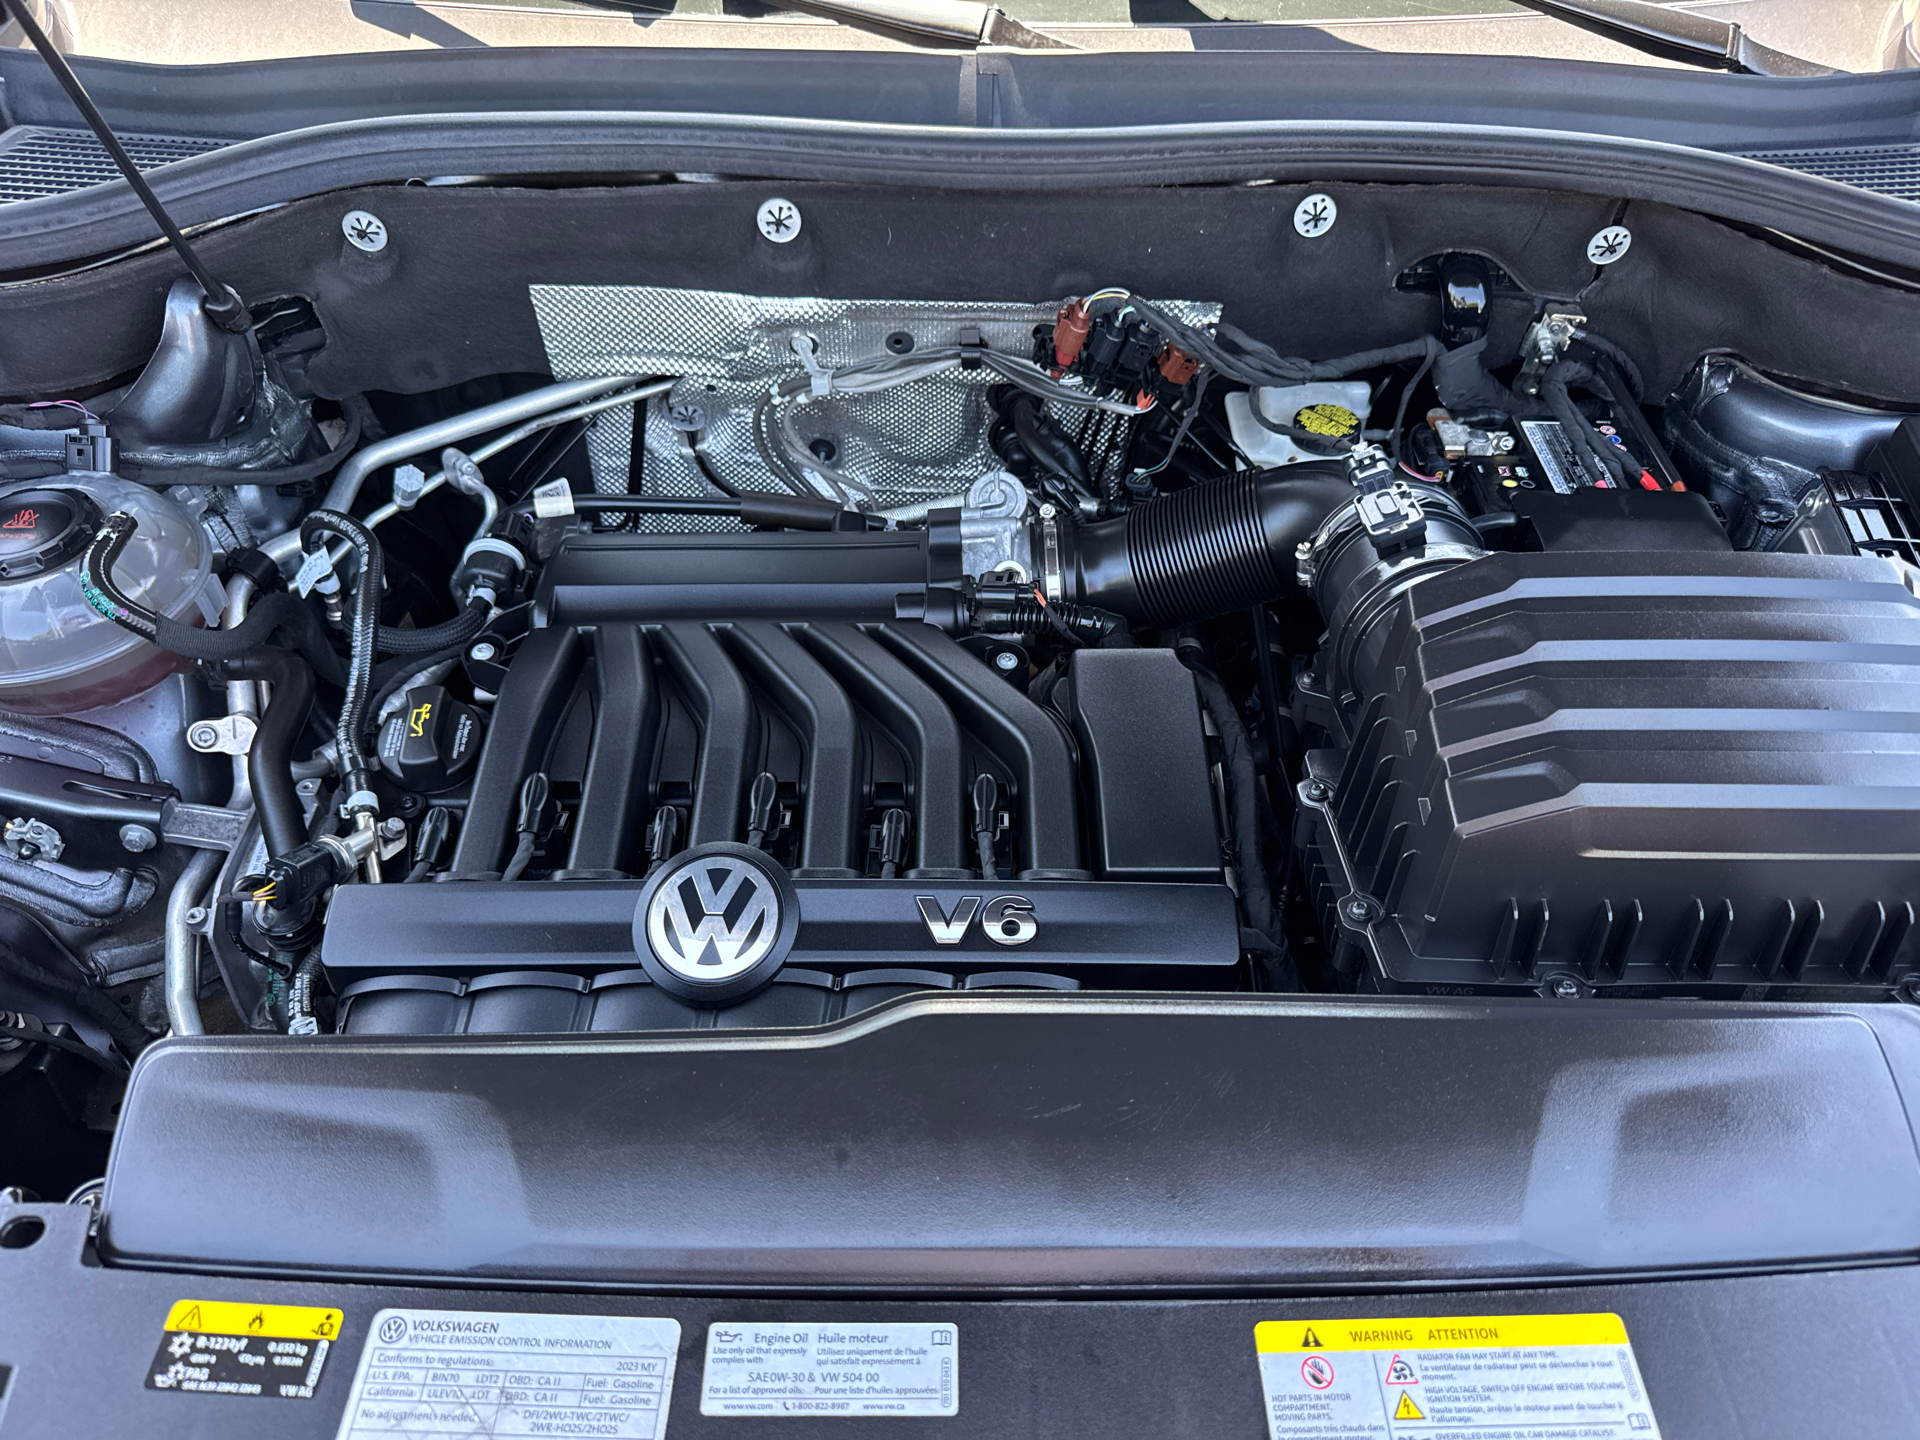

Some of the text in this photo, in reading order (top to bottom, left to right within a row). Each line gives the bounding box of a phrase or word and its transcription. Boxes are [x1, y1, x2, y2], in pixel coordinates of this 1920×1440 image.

[915, 895, 1039, 946] V6
[1426, 987, 1475, 995] VW AG
[413, 1320, 500, 1333] VOLKSWAGEN
[754, 1333, 808, 1345] Engine Oil
[818, 1333, 888, 1343] Huile moteur
[1350, 1330, 1413, 1342] WARNING
[1428, 1328, 1499, 1340] ATTENTION
[196, 1336, 248, 1353] R-1234yf
[409, 1334, 612, 1349] VEHICLE EMISSION CONTROL INFORMATION
[728, 1347, 745, 1356] only
[772, 1347, 806, 1356] expressly
[817, 1348, 928, 1357] Utilisez uniquement de l'huile
[377, 1353, 493, 1366] Conforms to regulations:
[712, 1356, 763, 1365] complies with
[816, 1357, 920, 1366] qui satisfait expressément à
[617, 1362, 657, 1371] 2023 MY
[1430, 1363, 1470, 1371] ventilateur
[1484, 1362, 1517, 1370] radiateur
[1520, 1362, 1537, 1370] peut
[1549, 1360, 1588, 1368] déclencher
[185, 1367, 210, 1381] PAG
[748, 1372, 879, 1383] SAE0W-30 & VW 504 00
[372, 1371, 389, 1379] U.S.
[392, 1372, 413, 1381] EPA:
[432, 1373, 460, 1382] BIN70
[476, 1374, 499, 1383] LDT2
[508, 1375, 532, 1385] OBD:
[537, 1376, 550, 1385] CA
[587, 1378, 608, 1387] Fuel:
[613, 1379, 654, 1389] Gasoline
[279, 1384, 298, 1397] VW
[299, 1386, 313, 1398] AG
[709, 1386, 721, 1394] For
[729, 1386, 740, 1394] list
[742, 1386, 749, 1394] of
[750, 1386, 787, 1395] approved
[788, 1386, 804, 1394] oils:
[895, 1387, 939, 1396] approuvées:
[1481, 1384, 1509, 1392] SWITCH
[1511, 1384, 1525, 1392] OFF
[1527, 1383, 1554, 1391] ENGINE
[1587, 1382, 1625, 1390] TOUCHING
[368, 1386, 416, 1397] California:
[472, 1390, 490, 1399] LDT
[505, 1391, 529, 1400] OBD:
[534, 1392, 548, 1401] CA
[583, 1395, 605, 1404] Fuel:
[610, 1395, 651, 1405] Gasoline
[1289, 1394, 1312, 1402] PARTS
[1323, 1393, 1351, 1401] MOTOR
[1273, 1403, 1332, 1411] COMPARTMENT.
[1454, 1405, 1485, 1413] tension,
[1487, 1404, 1512, 1412] arrêter
[1576, 1402, 1585, 1410] de
[1587, 1401, 1616, 1409] toucher
[1618, 1401, 1623, 1409] à
[361, 1409, 375, 1418] No
[377, 1410, 437, 1421] adjustments
[524, 1410, 630, 1422] DFI/2WU-TWC/2TWC/
[1275, 1413, 1306, 1421] MOVING
[1432, 1415, 1474, 1423] l'allumage.
[530, 1422, 618, 1434] 2WR-HO2S/2HO2S
[1276, 1423, 1386, 1434] Composants très chauds dans
[1436, 1432, 1481, 1440] OVERFILLED
[1483, 1431, 1511, 1439] ENGINE
[1513, 1430, 1525, 1439] OIL
[1527, 1430, 1543, 1438] CAN
[1545, 1429, 1577, 1437] DAMAGE
